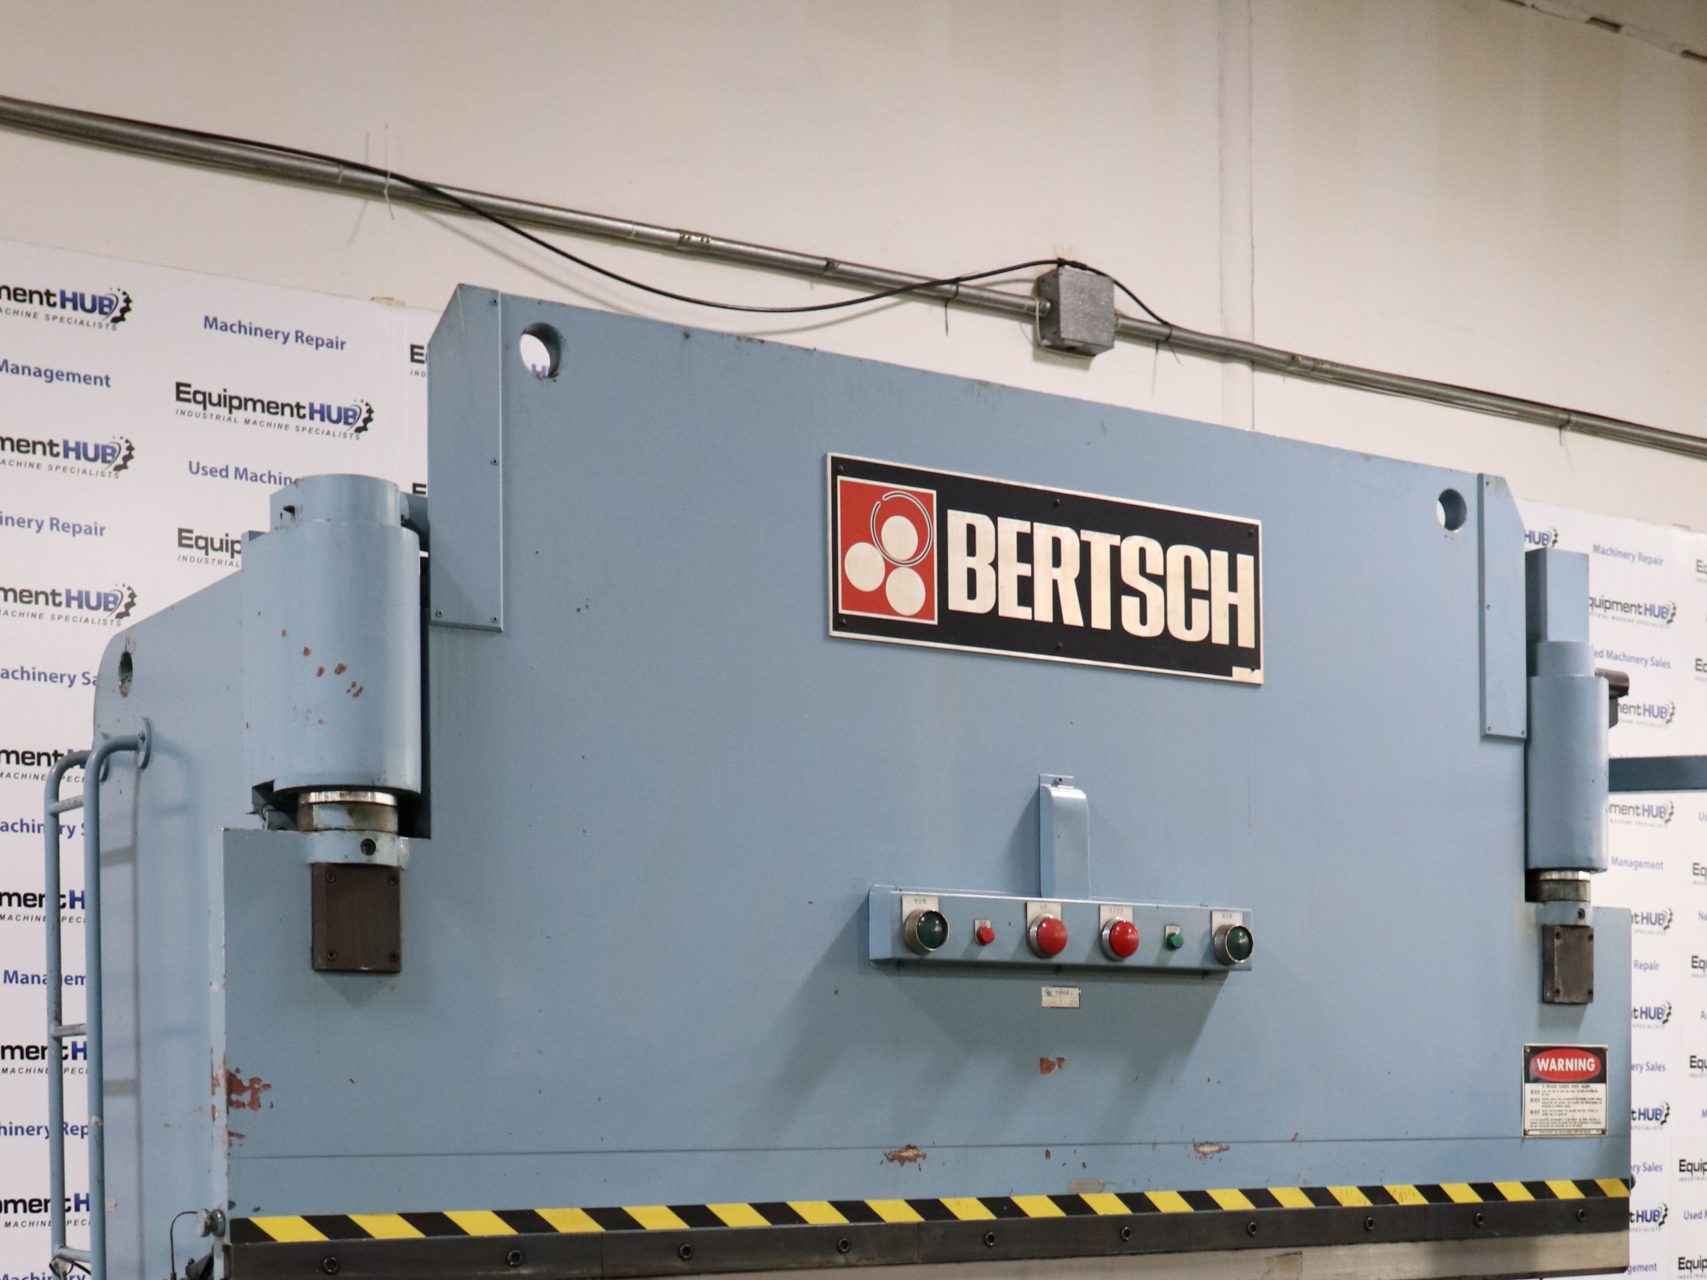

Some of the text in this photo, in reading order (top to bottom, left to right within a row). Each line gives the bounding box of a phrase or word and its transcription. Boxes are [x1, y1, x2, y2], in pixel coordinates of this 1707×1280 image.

[45, 313, 118, 331] SPECIALISTS
[203, 315, 347, 351] Machinery Repair
[175, 382, 360, 426] EquipmentHUB
[175, 408, 361, 441] INDUSTRIAL MACHINE SPECIALISTS
[48, 463, 120, 479] SPECIALISTS
[188, 460, 229, 479] Used
[50, 516, 106, 538] Repair
[177, 554, 241, 568] INDUSTRIAL
[1593, 543, 1664, 566] Machinery Repair
[947, 509, 1255, 649] BERTSCH
[50, 613, 122, 627] SPECIALISTS
[1605, 649, 1648, 667] Machinery
[1650, 656, 1671, 669] Sales
[1611, 855, 1664, 870] Management
[1634, 959, 1659, 972] Repair
[1536, 1058, 1596, 1071] WARNING
[1645, 1061, 1666, 1072] Sales
[1642, 1161, 1663, 1172] Sales
[1684, 1209, 1702, 1221] Used
